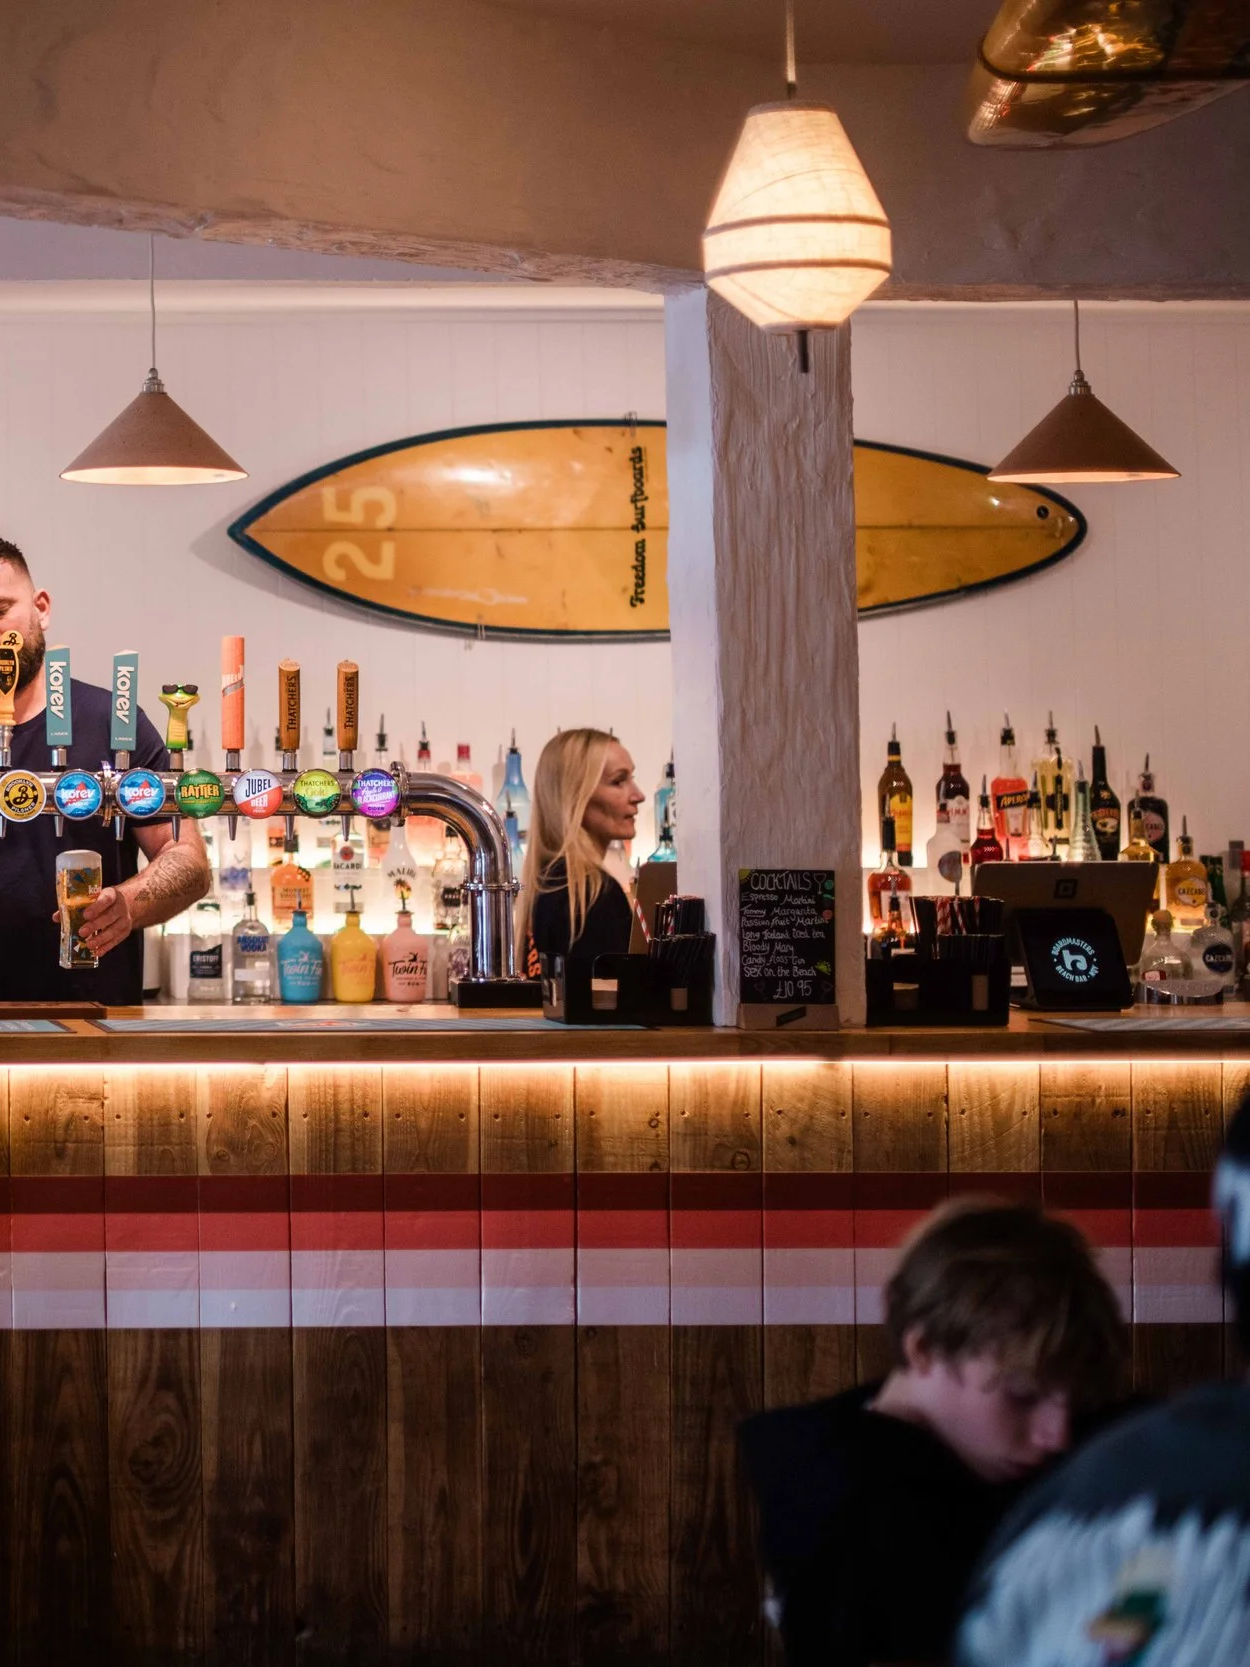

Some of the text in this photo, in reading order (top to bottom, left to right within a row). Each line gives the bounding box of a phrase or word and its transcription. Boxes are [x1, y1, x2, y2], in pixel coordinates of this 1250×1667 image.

[322, 486, 397, 582] 25
[629, 446, 648, 608] Freedom Surfboards
[49, 661, 67, 720] korev
[116, 666, 135, 725] korev
[286, 675, 297, 732] THATCHERS
[344, 676, 355, 730] THATCHERS
[5, 778, 33, 791] BROOKLYN
[245, 778, 272, 798] JUBEL
[300, 780, 335, 788] THATCHERS
[357, 778, 395, 788] THATCHERS
[61, 787, 96, 799] korev
[124, 786, 159, 799] korev
[180, 784, 220, 799] RATTLER
[11, 802, 36, 813] PILSNER
[250, 794, 268, 808] BEER
[334, 862, 362, 870] BACARDI
[751, 871, 812, 891] COCKTAILS
[742, 892, 816, 905] Espresso Martini
[741, 904, 766, 917] Tommy
[237, 935, 269, 944] ABSOLUT
[1051, 937, 1095, 956] BOARDMASTERS
[773, 943, 794, 957] Mary
[281, 960, 308, 975] Twin
[388, 960, 417, 975] Twin
[764, 968, 775, 977] on
[777, 967, 789, 977] the
[1055, 965, 1074, 981] BEACH
[1075, 975, 1088, 983] BAR
